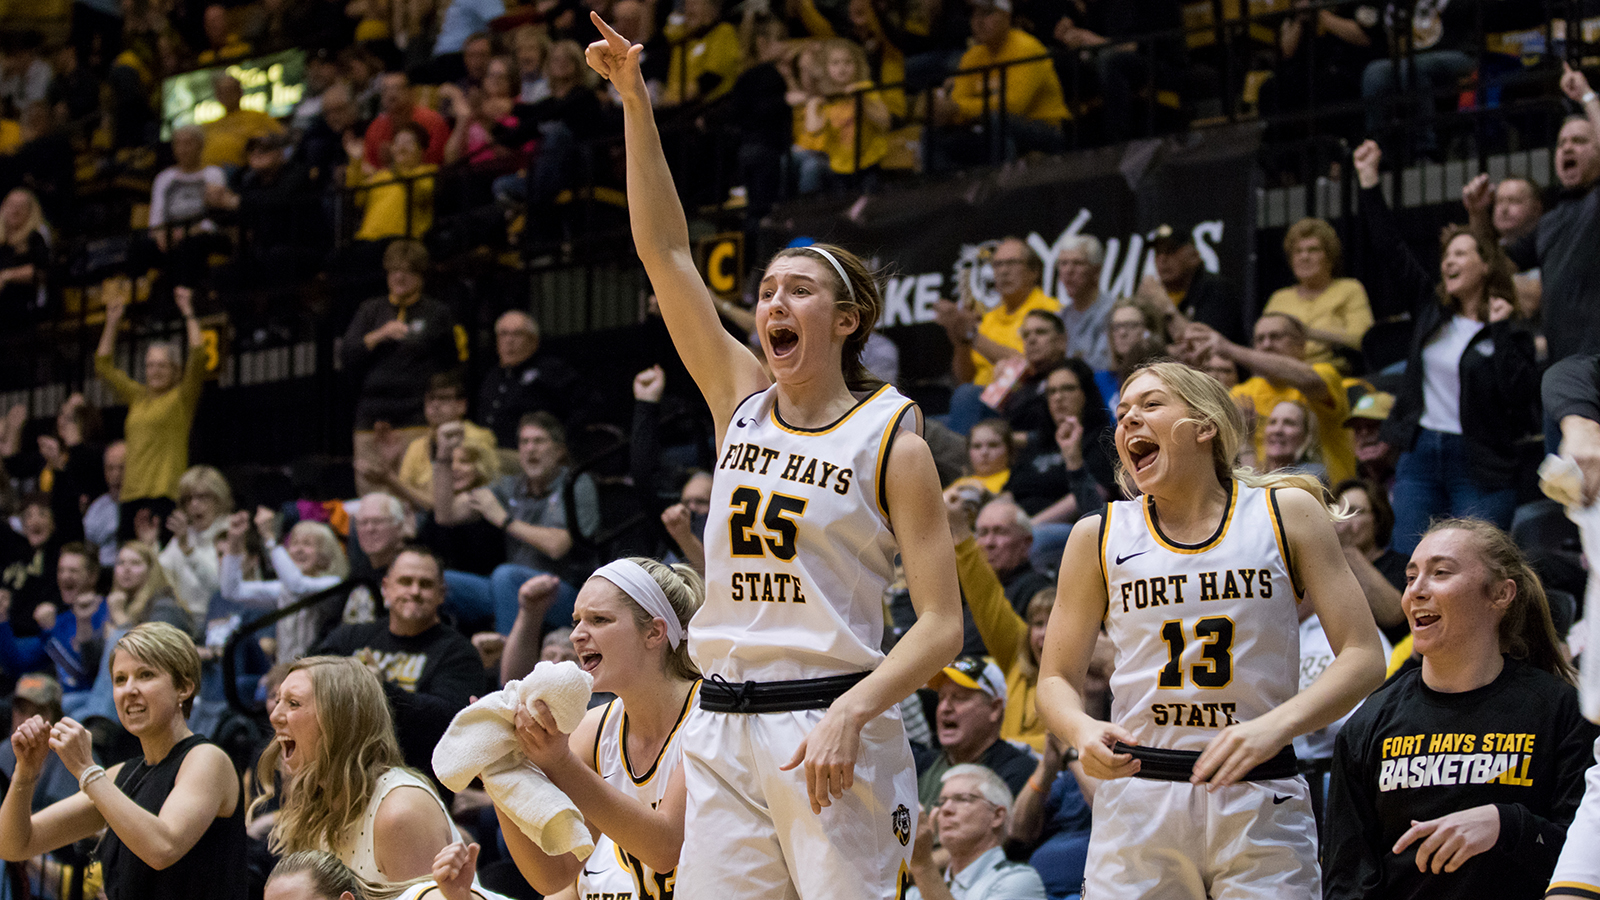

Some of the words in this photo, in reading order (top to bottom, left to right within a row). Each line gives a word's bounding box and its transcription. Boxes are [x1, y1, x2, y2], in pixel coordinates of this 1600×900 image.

[708, 242, 736, 291] C
[876, 273, 944, 328] KE
[719, 443, 780, 476] FORT
[780, 453, 853, 496] HAYS
[728, 484, 809, 563] 25
[731, 572, 806, 603] STATE
[1120, 574, 1187, 613] FORT
[1198, 569, 1273, 601] HAYS
[1157, 615, 1236, 690] 13
[1151, 702, 1240, 728] STATE
[1381, 734, 1425, 759] FORT
[1428, 733, 1477, 753] HAYS
[1481, 733, 1536, 753] STATE
[1379, 753, 1533, 792] BASKETBALL
